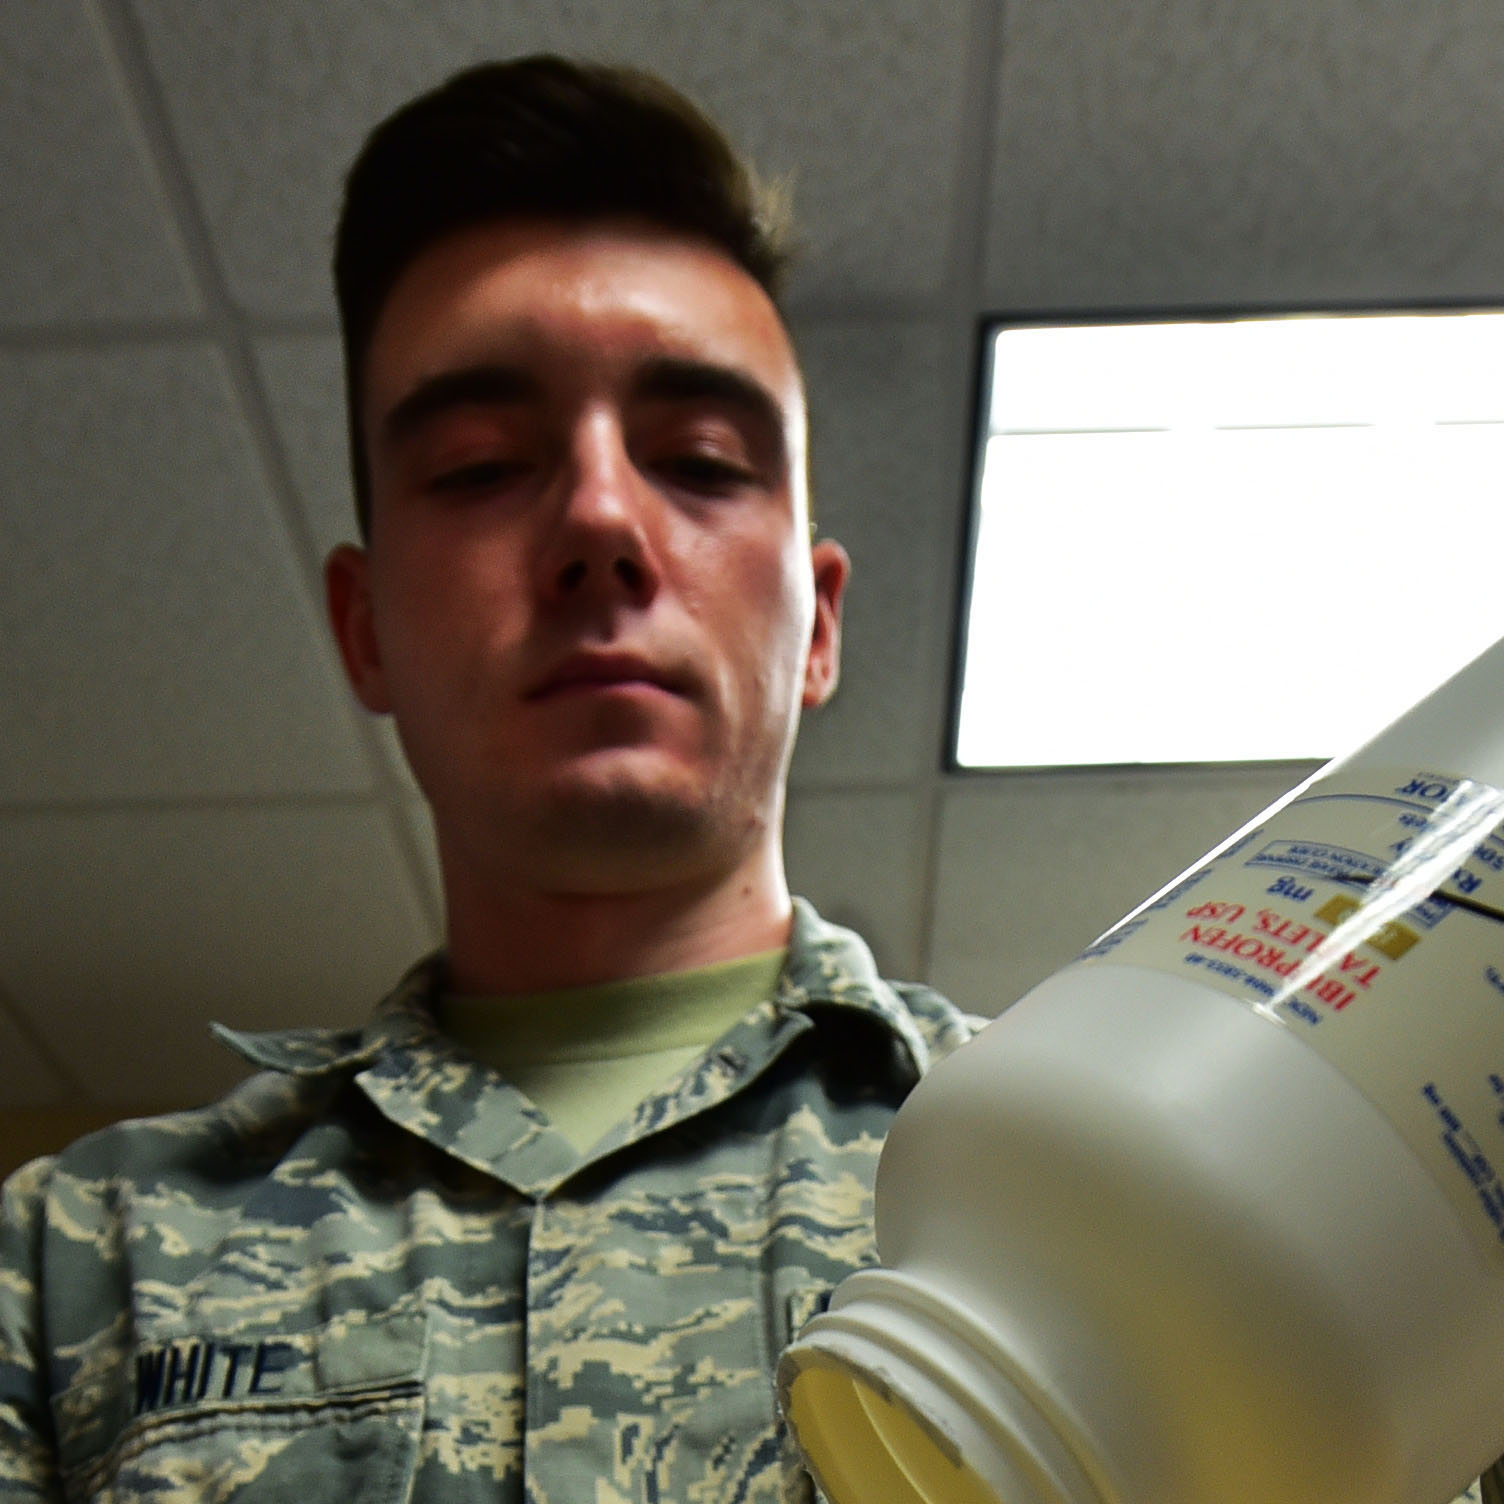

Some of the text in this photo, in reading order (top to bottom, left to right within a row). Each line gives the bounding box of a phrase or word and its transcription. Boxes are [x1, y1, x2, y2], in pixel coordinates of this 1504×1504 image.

[1186, 901, 1246, 924] USP
[1267, 875, 1315, 901] mg
[1253, 908, 1381, 989] TALETS,
[133, 1341, 293, 1416] WHITE
